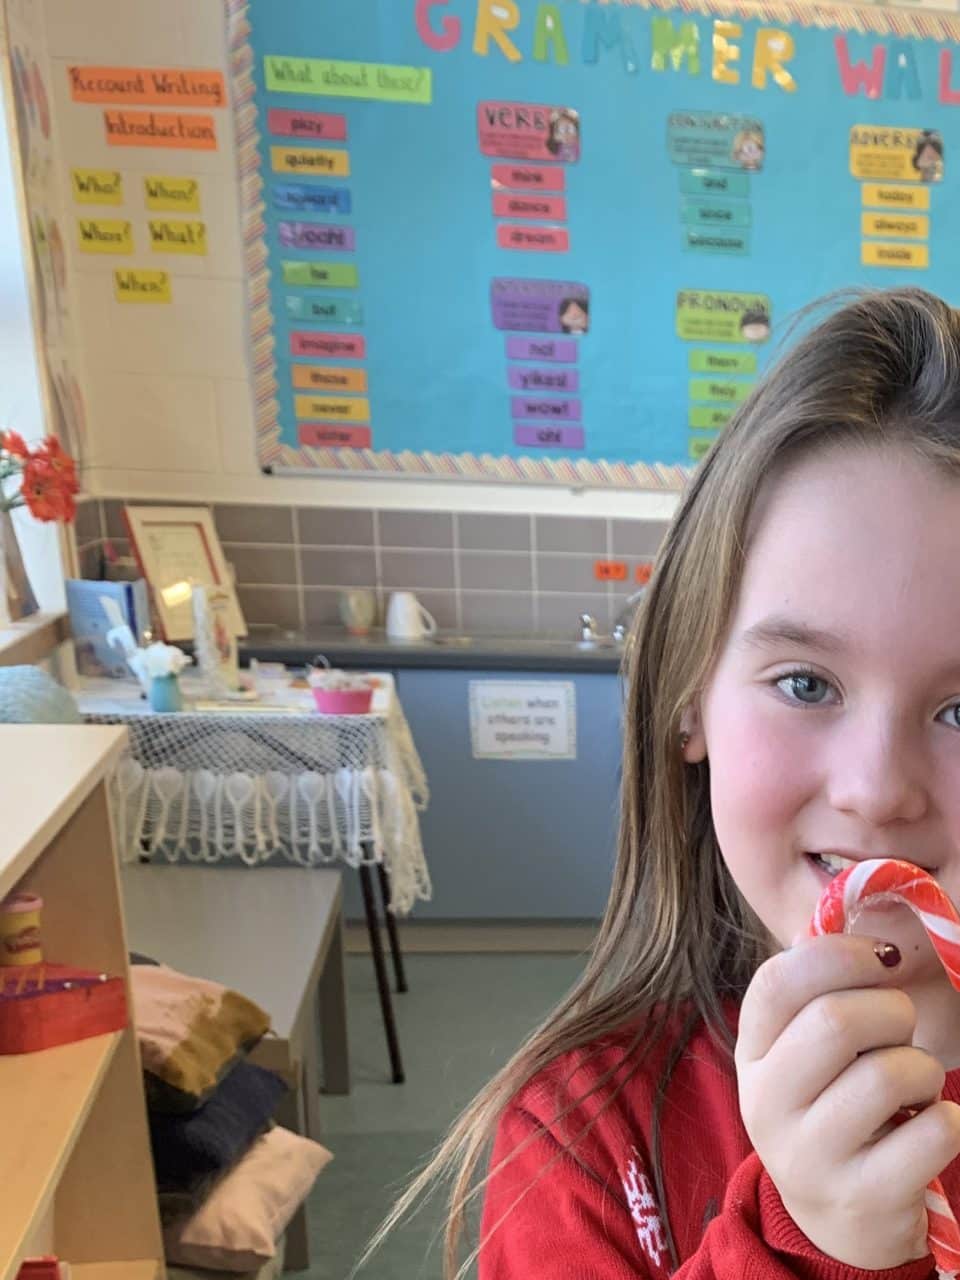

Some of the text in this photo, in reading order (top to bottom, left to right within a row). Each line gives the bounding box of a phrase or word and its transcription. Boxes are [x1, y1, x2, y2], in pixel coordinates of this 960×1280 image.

[415, 0, 797, 92] GRAMMER
[69, 66, 222, 102] Recount Writing
[270, 59, 313, 83] What
[322, 63, 368, 87] about
[104, 112, 216, 140] Introduction
[485, 108, 545, 130] VERB
